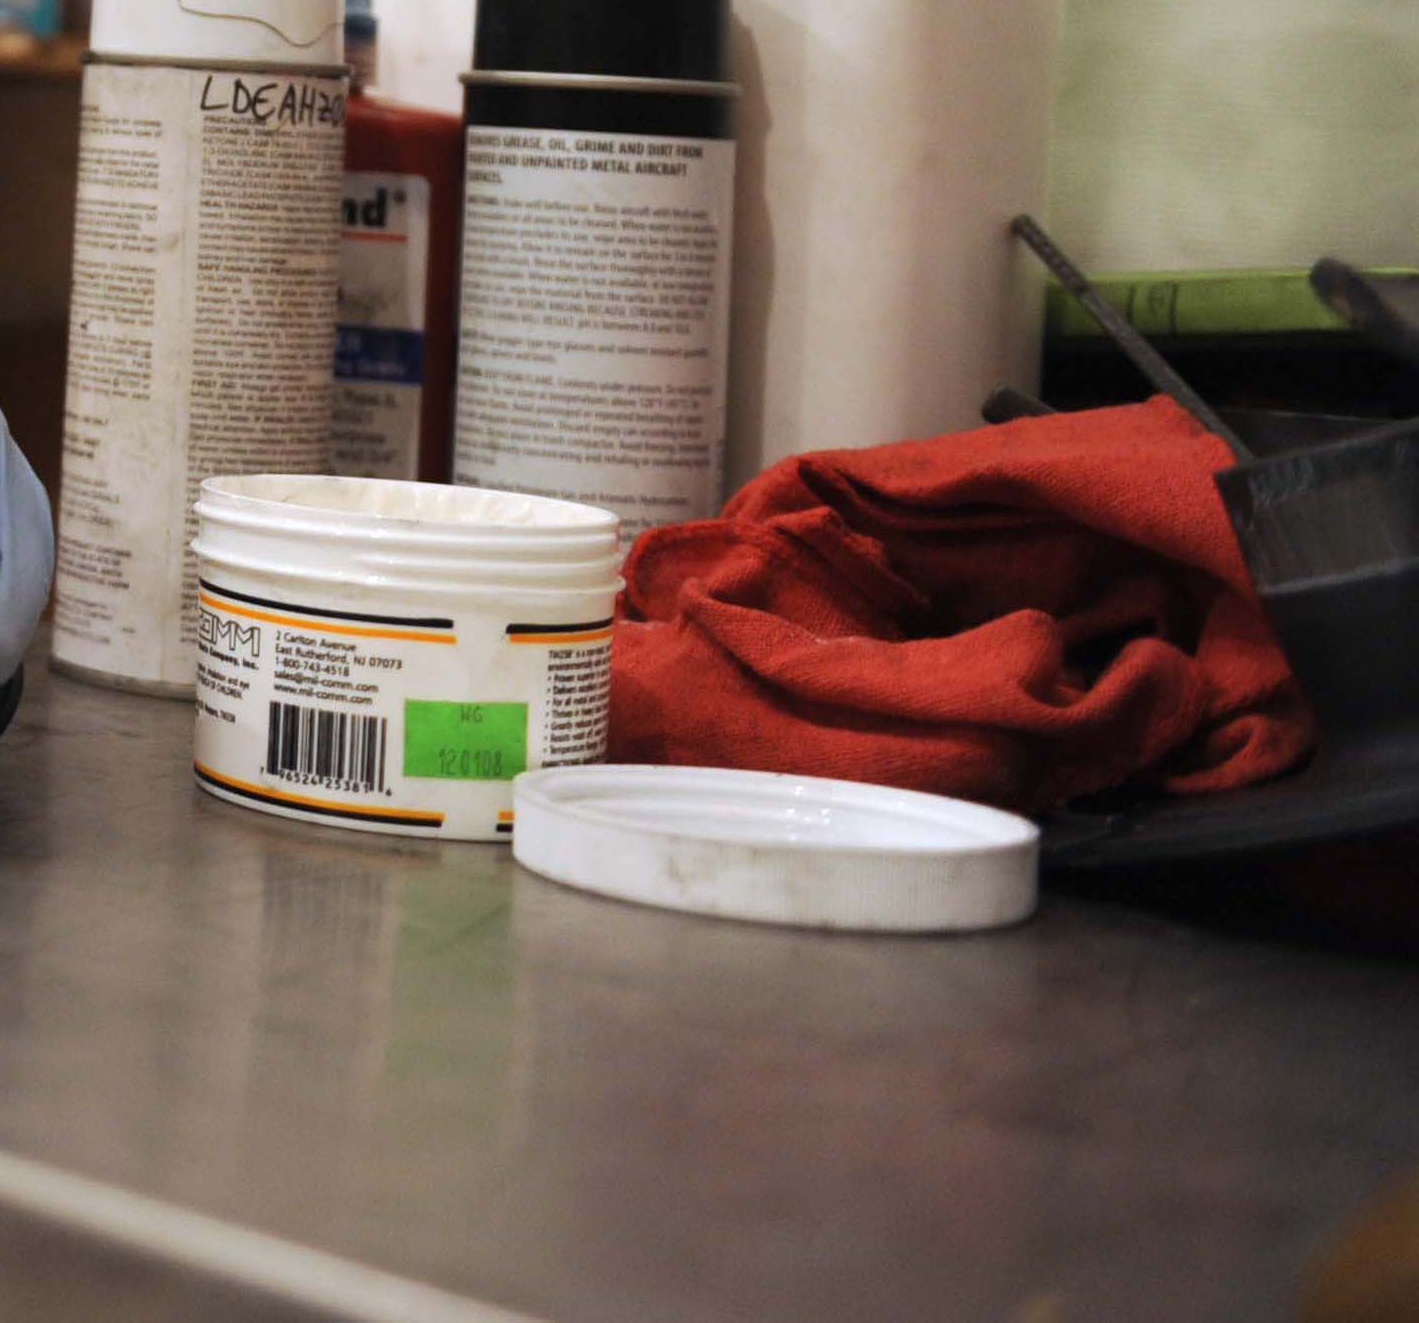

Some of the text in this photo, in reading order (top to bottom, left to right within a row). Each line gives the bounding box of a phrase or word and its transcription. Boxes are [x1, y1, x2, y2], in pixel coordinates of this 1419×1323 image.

[575, 139, 614, 154] GRIME
[619, 142, 644, 156] AND
[648, 143, 673, 158] DIRT
[522, 155, 588, 171] UNPAINTED
[591, 159, 631, 174] METAL
[635, 160, 688, 177] AIRCRAFT
[275, 630, 281, 641] 2
[320, 638, 357, 652] Avenue
[275, 643, 403, 670] East Rutherford, NJ 07073
[273, 683, 373, 705] www.mil-comm.com
